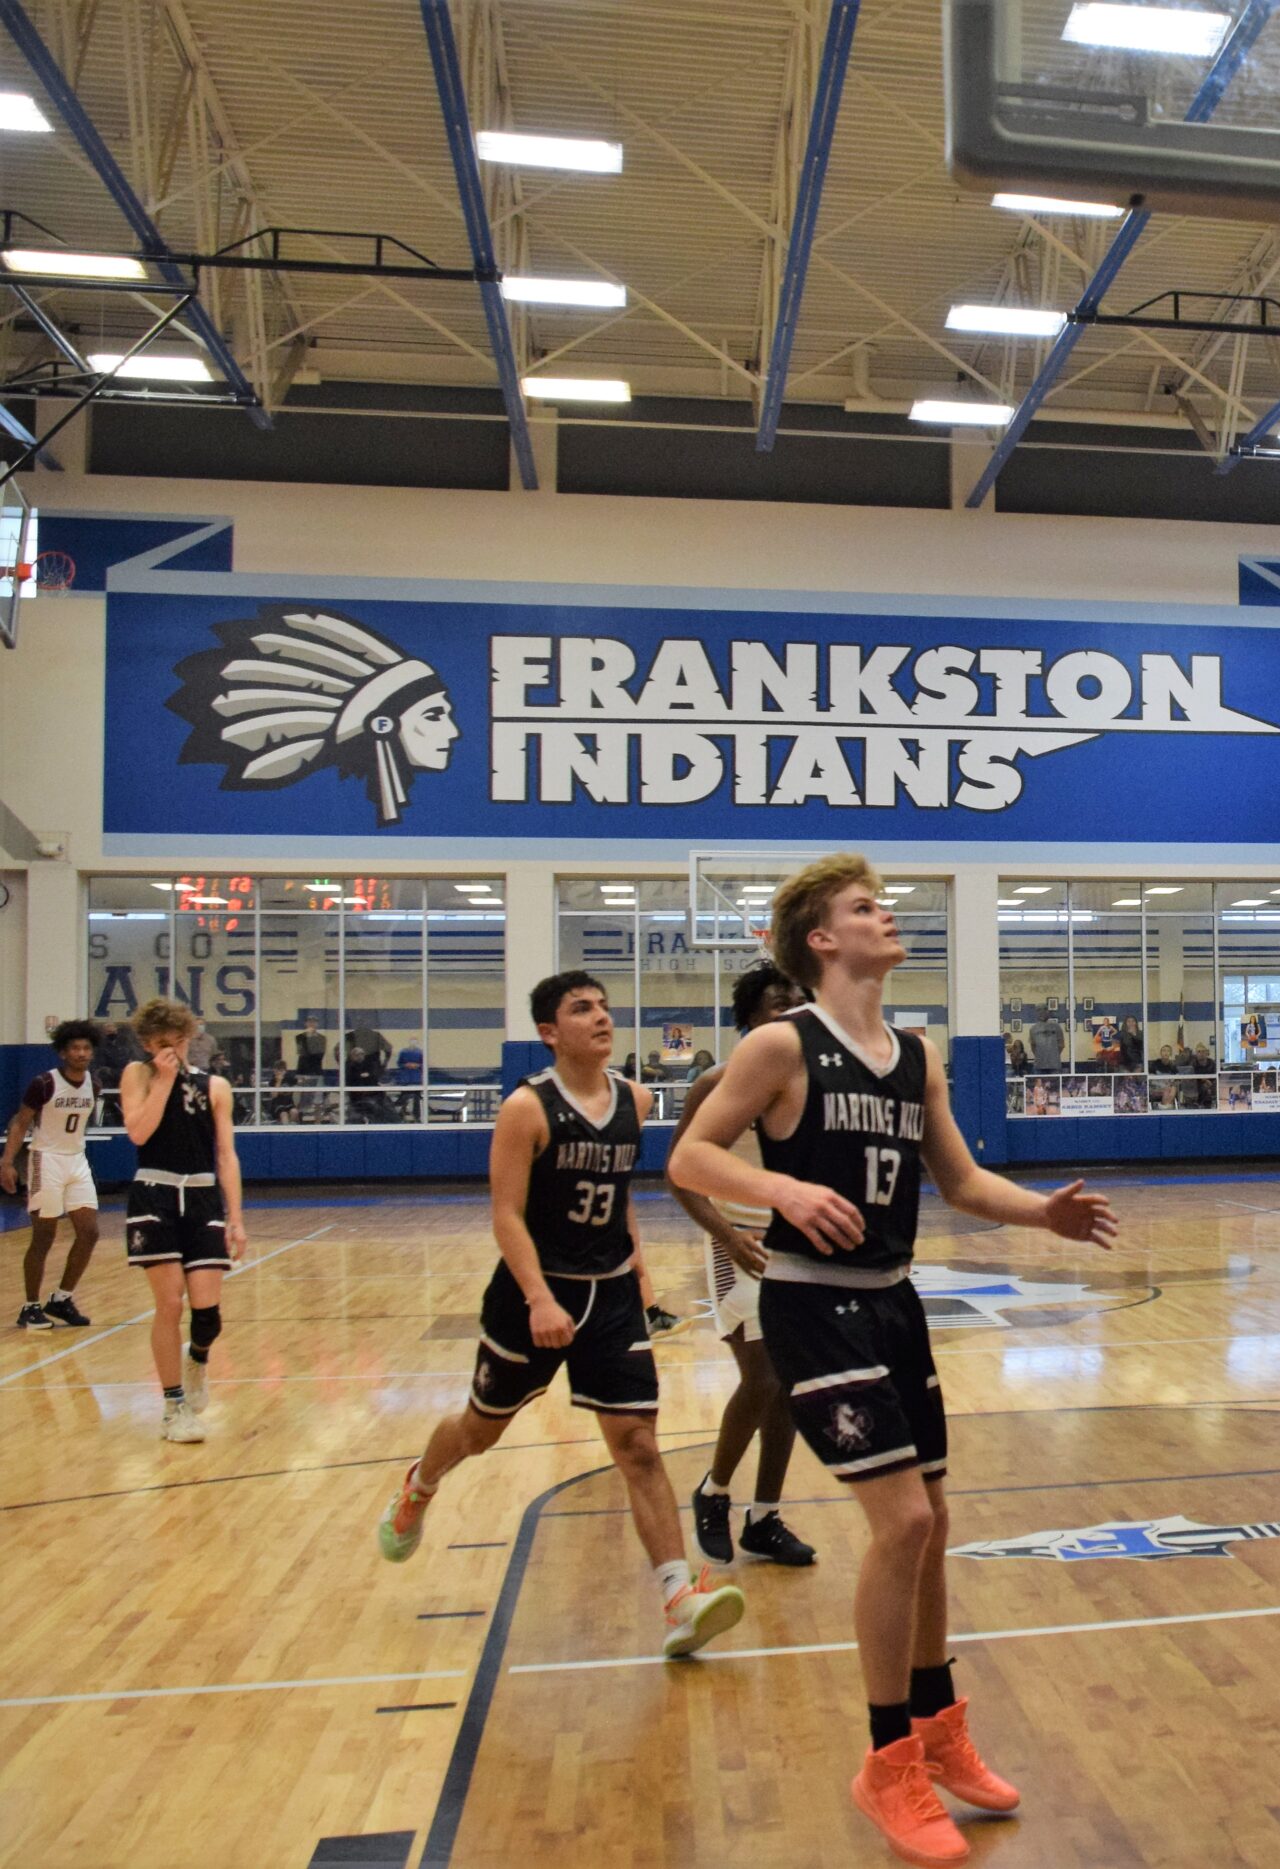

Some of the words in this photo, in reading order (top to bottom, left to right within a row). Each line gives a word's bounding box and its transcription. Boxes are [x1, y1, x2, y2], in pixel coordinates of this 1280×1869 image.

[377, 718, 388, 731] F
[491, 722, 1102, 811] INDIANS
[55, 1097, 91, 1108] GRAPELAN
[824, 1092, 895, 1136] MARTINS
[65, 1113, 80, 1134] 0
[556, 1141, 611, 1173] MARTINS
[864, 1146, 901, 1206] 13
[567, 1181, 615, 1226] 33
